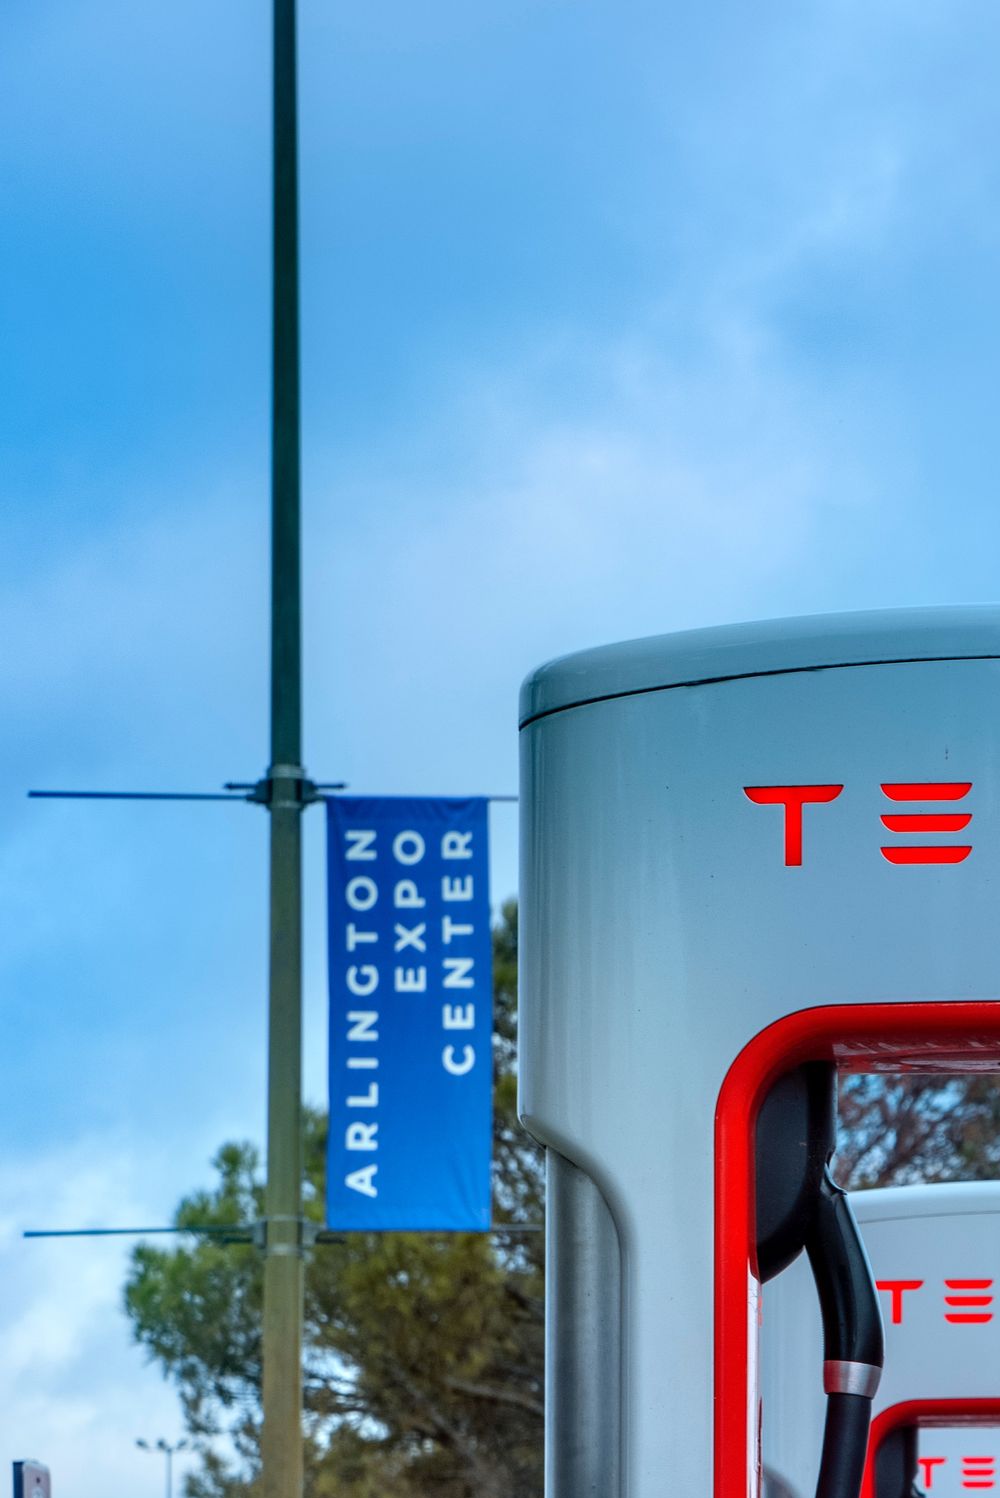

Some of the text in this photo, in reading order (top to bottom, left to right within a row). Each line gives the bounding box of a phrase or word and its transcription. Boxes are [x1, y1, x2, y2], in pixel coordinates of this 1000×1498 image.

[345, 830, 379, 1198] ARLINGTON
[393, 830, 426, 992] EXPO
[441, 831, 475, 1076] CENTER
